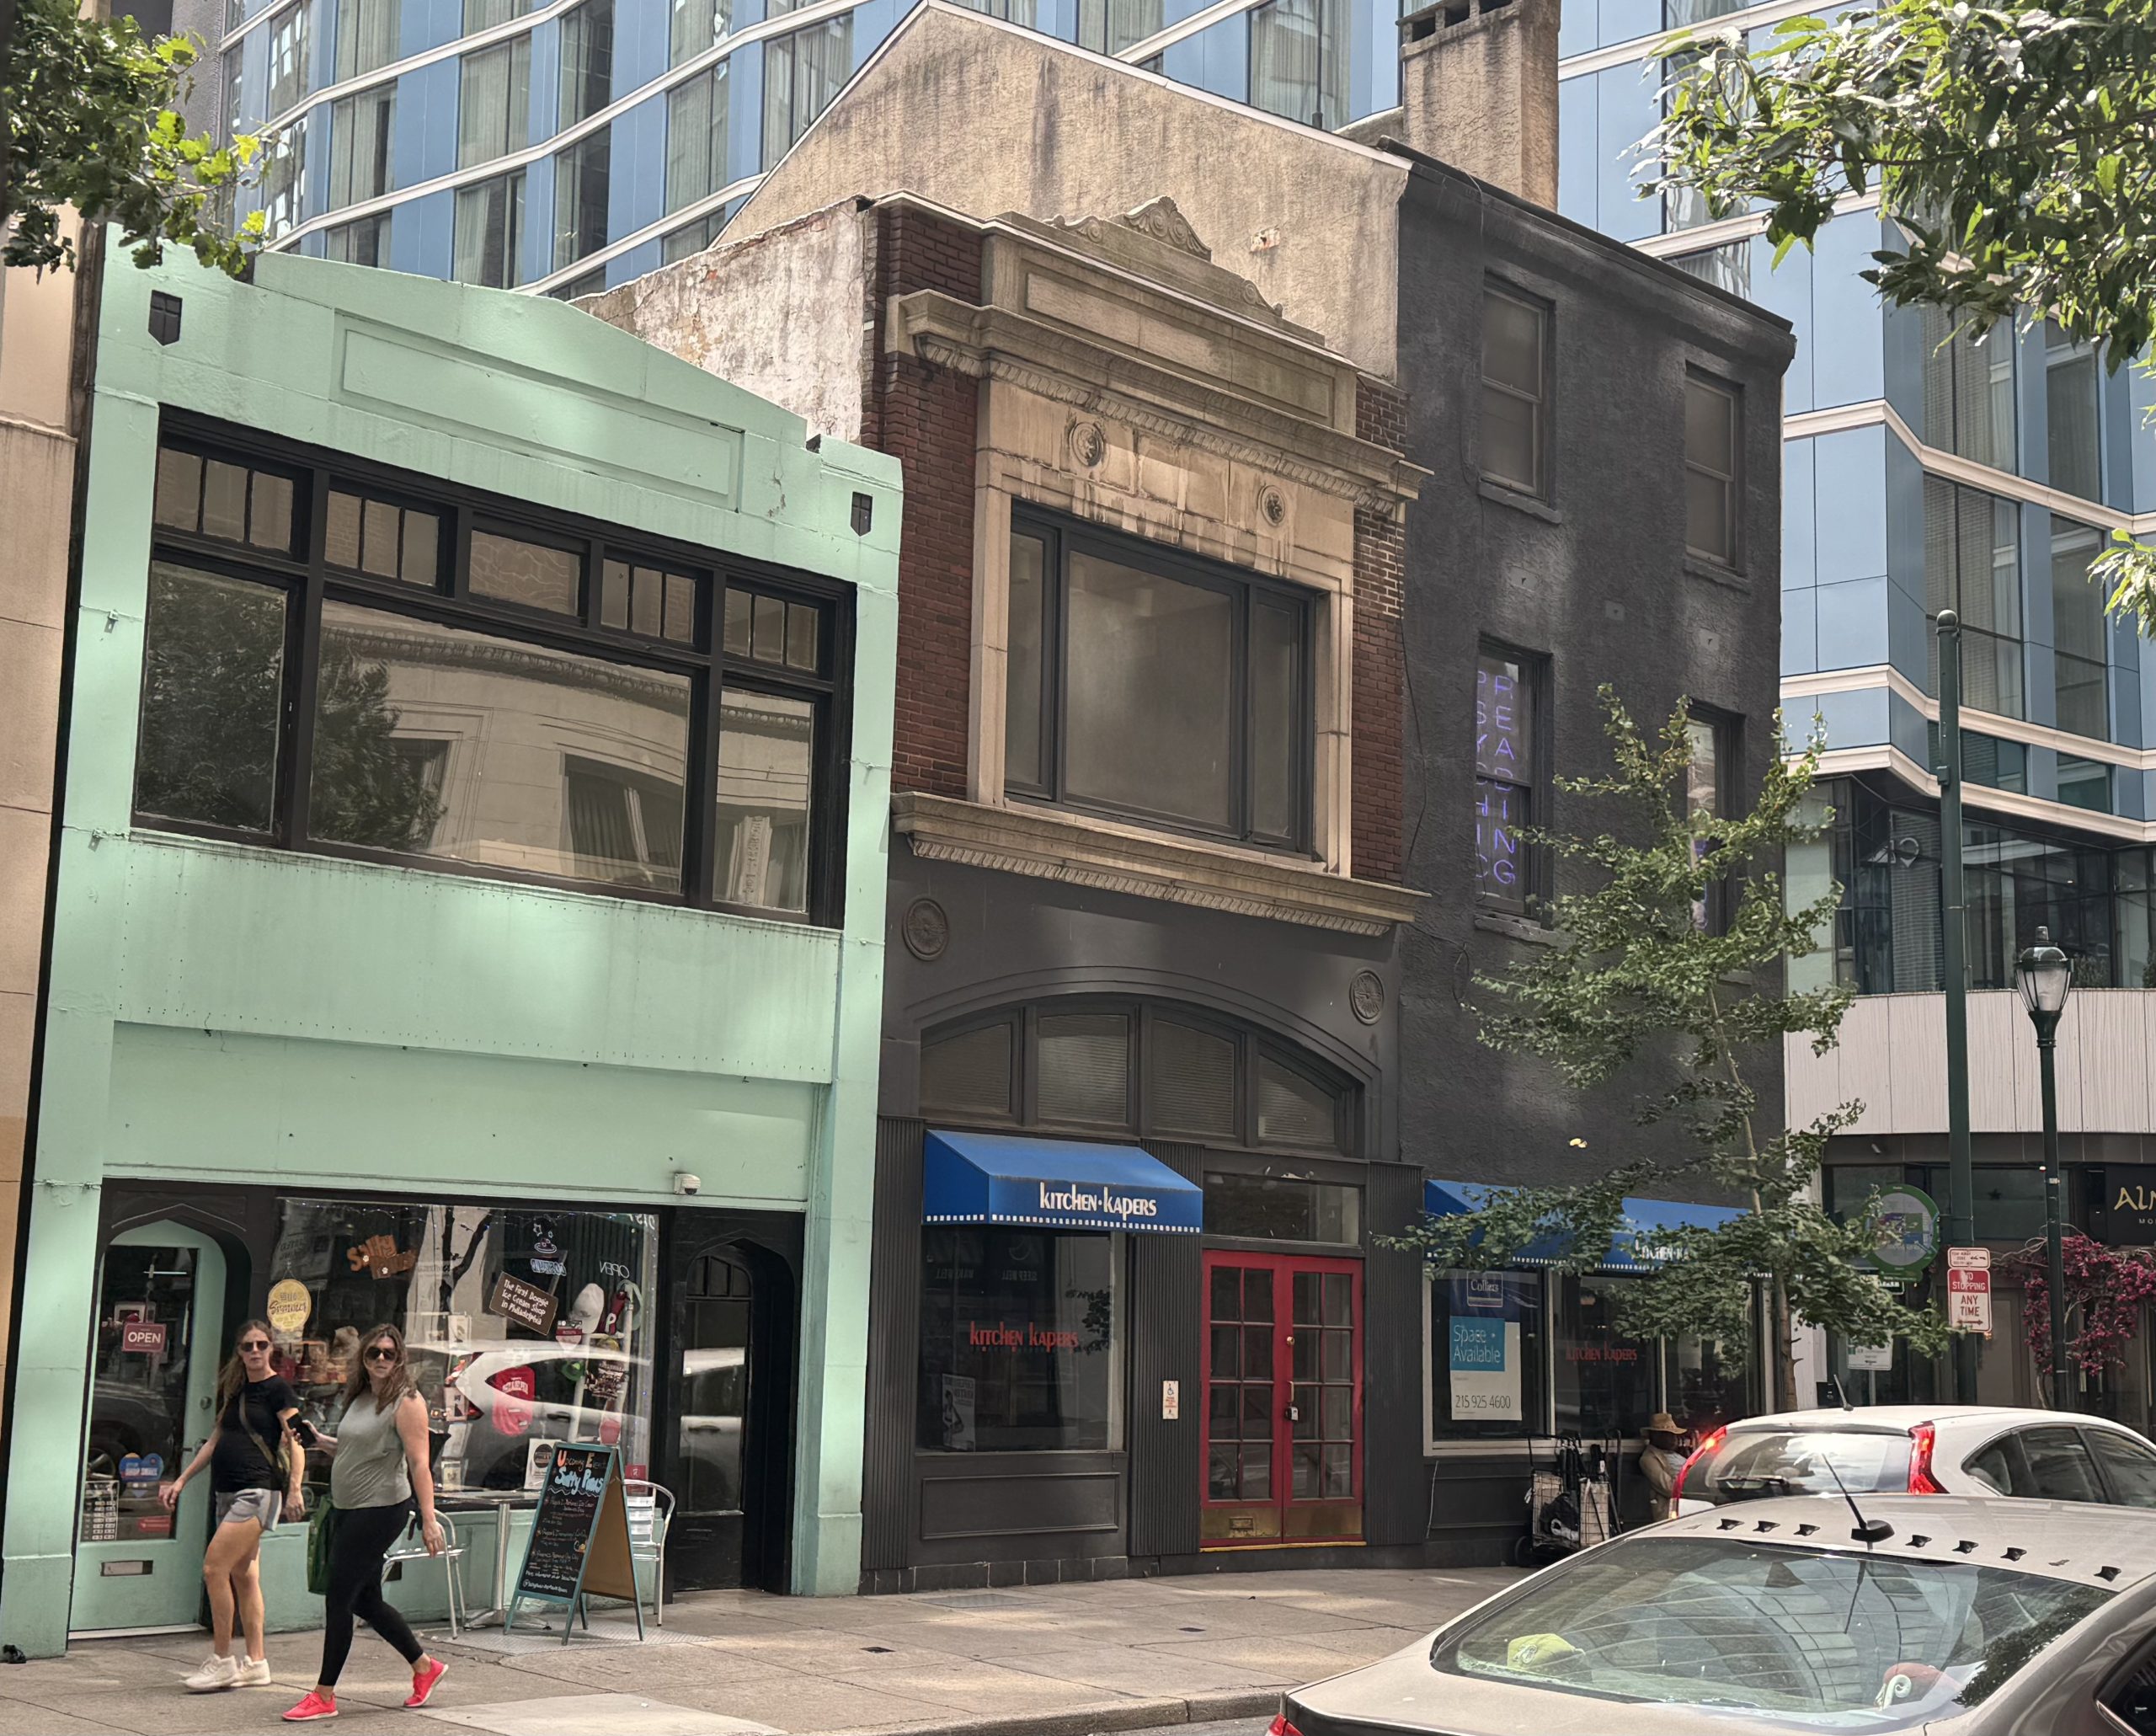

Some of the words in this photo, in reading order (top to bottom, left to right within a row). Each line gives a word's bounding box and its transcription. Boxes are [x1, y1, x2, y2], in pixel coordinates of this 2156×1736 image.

[1493, 674, 1516, 885] READING
[504, 1279, 515, 1291] The
[515, 1285, 529, 1298] First
[1470, 1279, 1499, 1293] Colliers
[1952, 1281, 1986, 1291] STOPPING
[502, 1289, 512, 1301] Ice
[512, 1295, 531, 1309] Cream
[1961, 1295, 1978, 1305] ANY
[1961, 1306, 1980, 1317] TIME
[127, 1331, 162, 1344] OPEN
[1454, 1324, 1487, 1347] Space
[1453, 1344, 1502, 1364] Available
[1455, 1394, 1470, 1408] 215
[1472, 1395, 1487, 1408] 925
[1489, 1395, 1512, 1409] 4600
[554, 1466, 581, 1495] Salty
[581, 1468, 604, 1493] Paws
